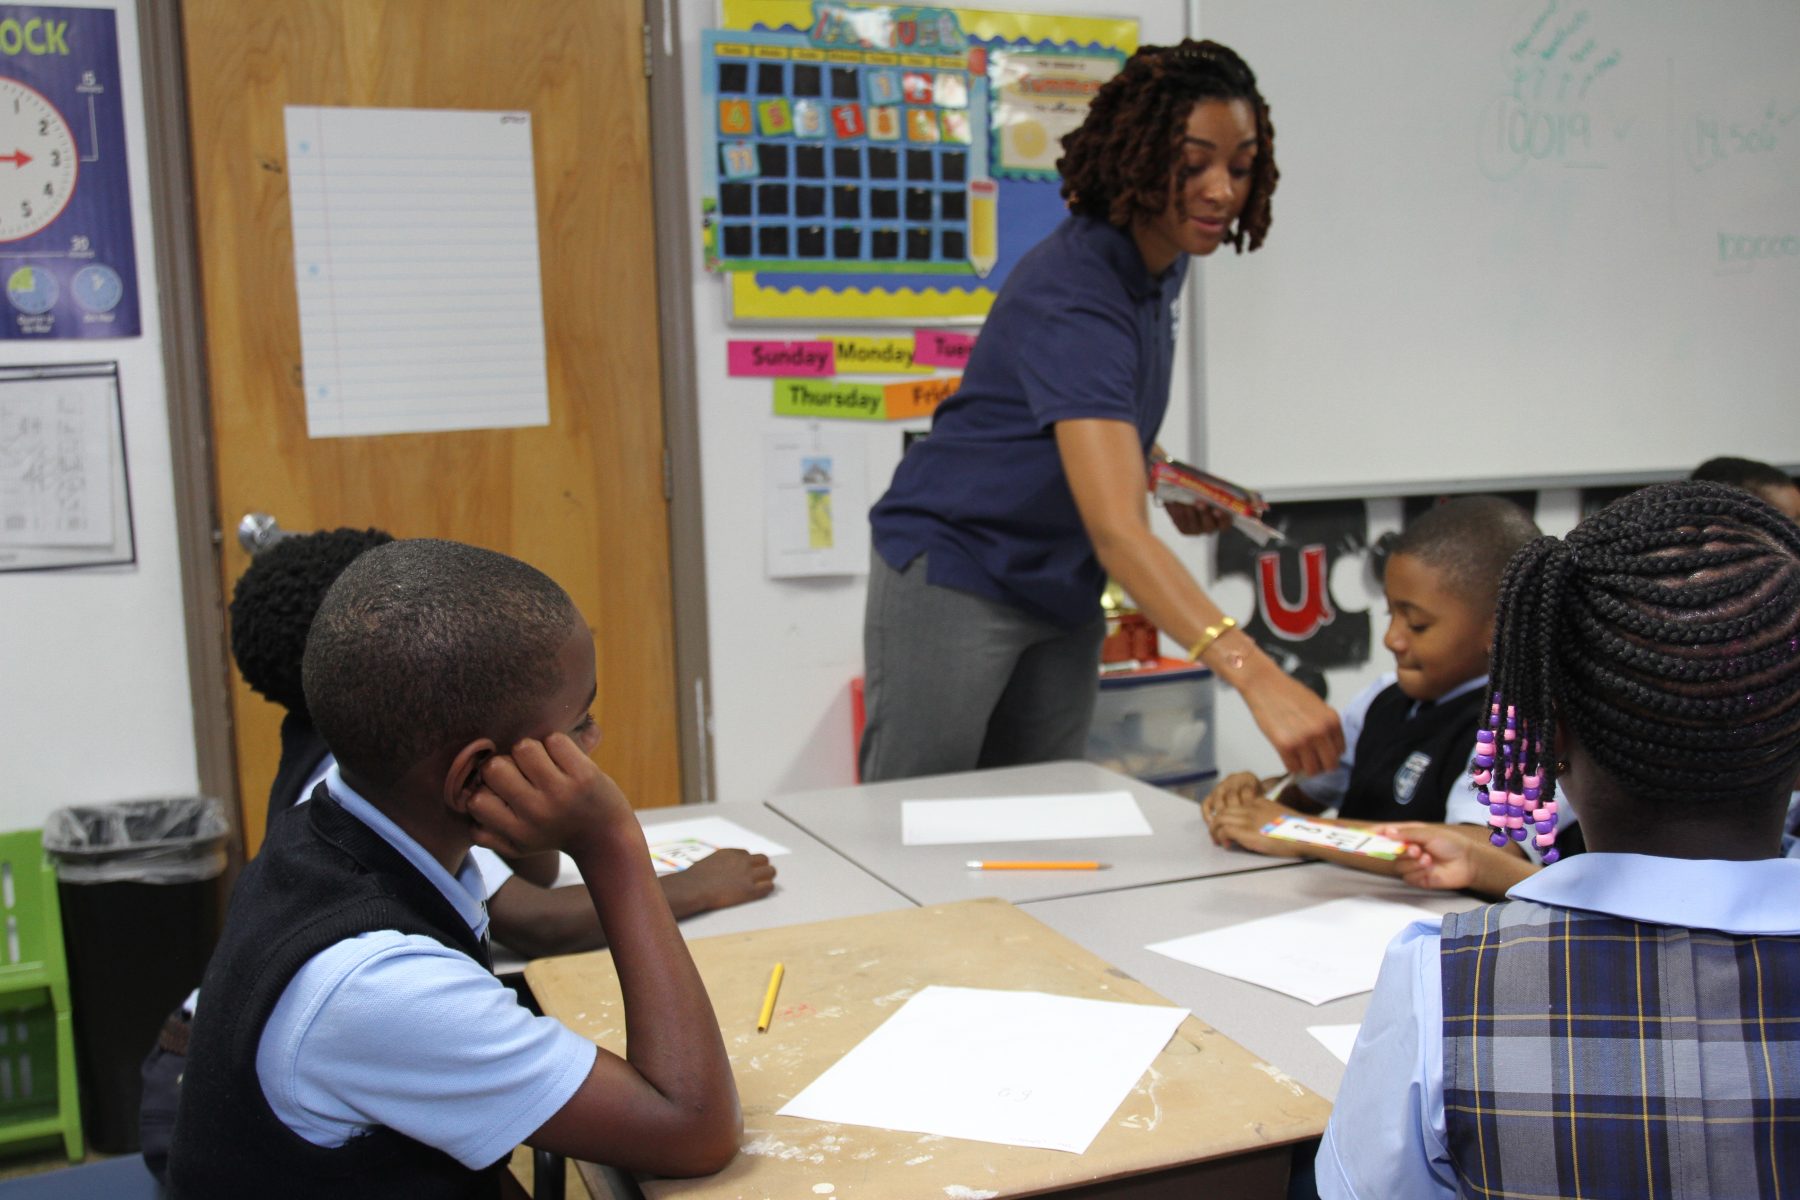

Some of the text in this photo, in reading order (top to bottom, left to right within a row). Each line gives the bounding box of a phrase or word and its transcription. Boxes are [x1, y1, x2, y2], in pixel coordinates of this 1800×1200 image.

[0, 16, 70, 56] OCK
[39, 119, 49, 137] 2
[50, 149, 61, 168] 3
[43, 181, 53, 196] 4
[21, 199, 32, 218] 5
[752, 345, 829, 371] Sunday
[837, 342, 915, 368] Monday
[789, 385, 883, 413] Thursday
